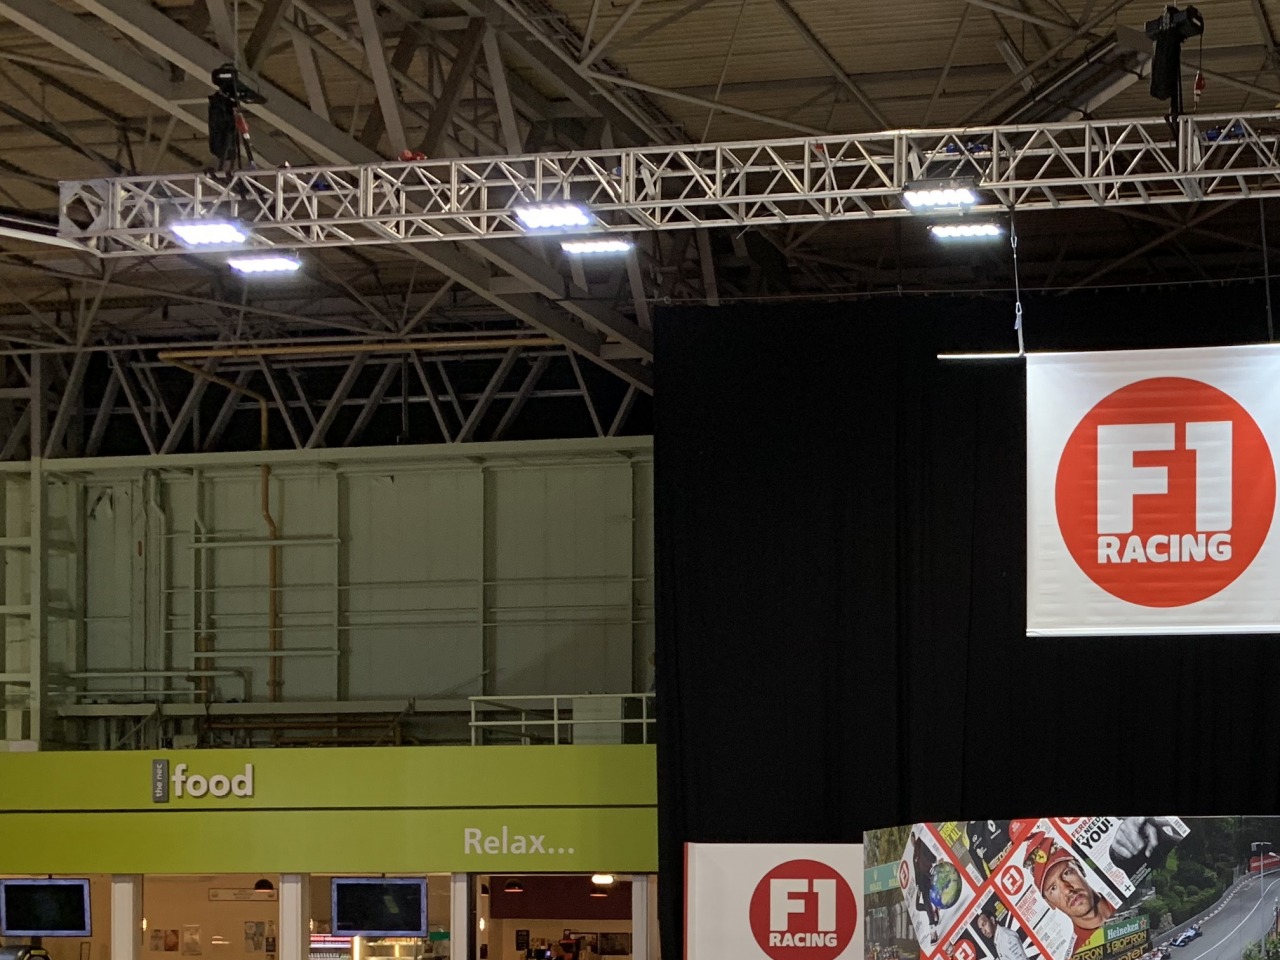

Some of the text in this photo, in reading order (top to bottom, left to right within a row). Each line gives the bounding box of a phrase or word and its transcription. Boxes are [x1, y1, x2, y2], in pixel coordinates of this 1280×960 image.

[1097, 421, 1233, 534] F1
[1097, 534, 1232, 563] RACING
[172, 763, 254, 797] food
[464, 825, 575, 855] Relax...
[1081, 818, 1113, 850] YOU!
[1002, 867, 1022, 891] F1
[770, 879, 837, 931] F1
[769, 933, 838, 947] RACING
[1107, 921, 1140, 940] Heineken
